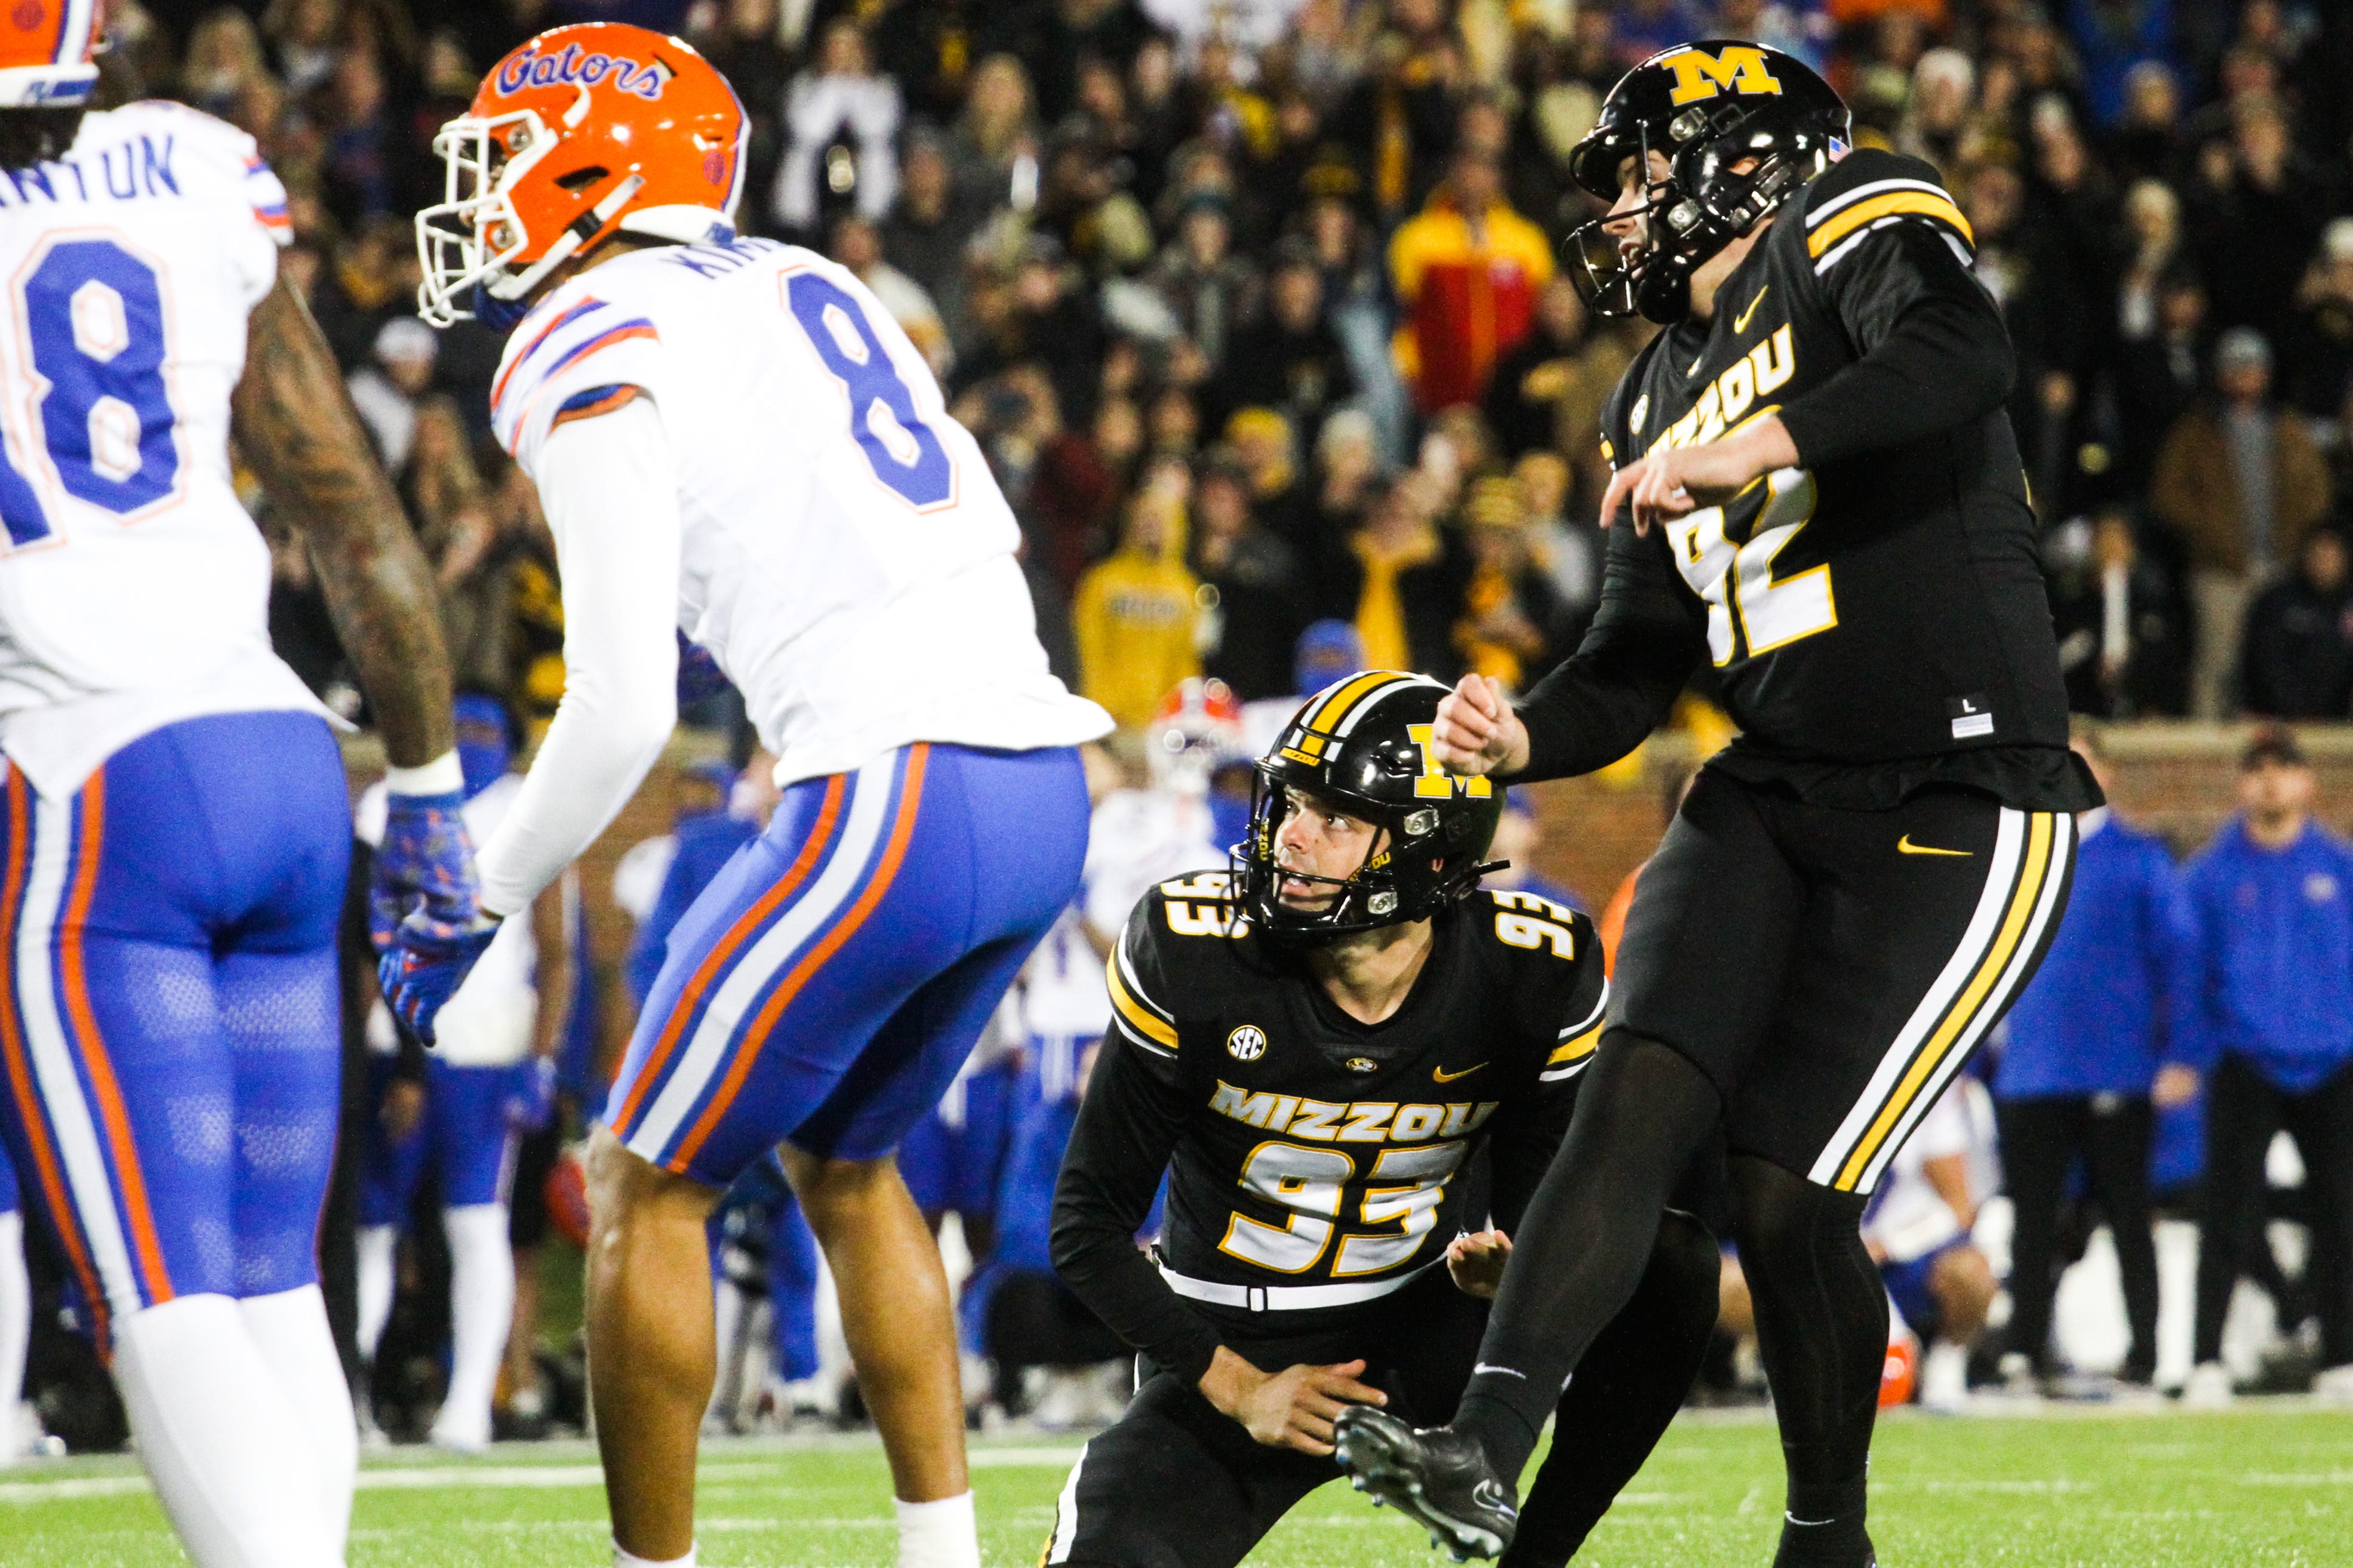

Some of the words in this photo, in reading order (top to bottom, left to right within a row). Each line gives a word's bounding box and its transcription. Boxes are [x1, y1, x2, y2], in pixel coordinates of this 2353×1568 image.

[496, 42, 661, 100] Gators
[1660, 45, 1782, 106] M
[0, 227, 191, 557] 8
[778, 264, 959, 515] 8
[1962, 698, 1977, 713] L
[1160, 873, 1250, 939] 93
[1491, 889, 1574, 962] 93
[1228, 1027, 1265, 1059] SEC
[1208, 1079, 1499, 1142] MIZZOU
[1216, 1139, 1471, 1278] 93
